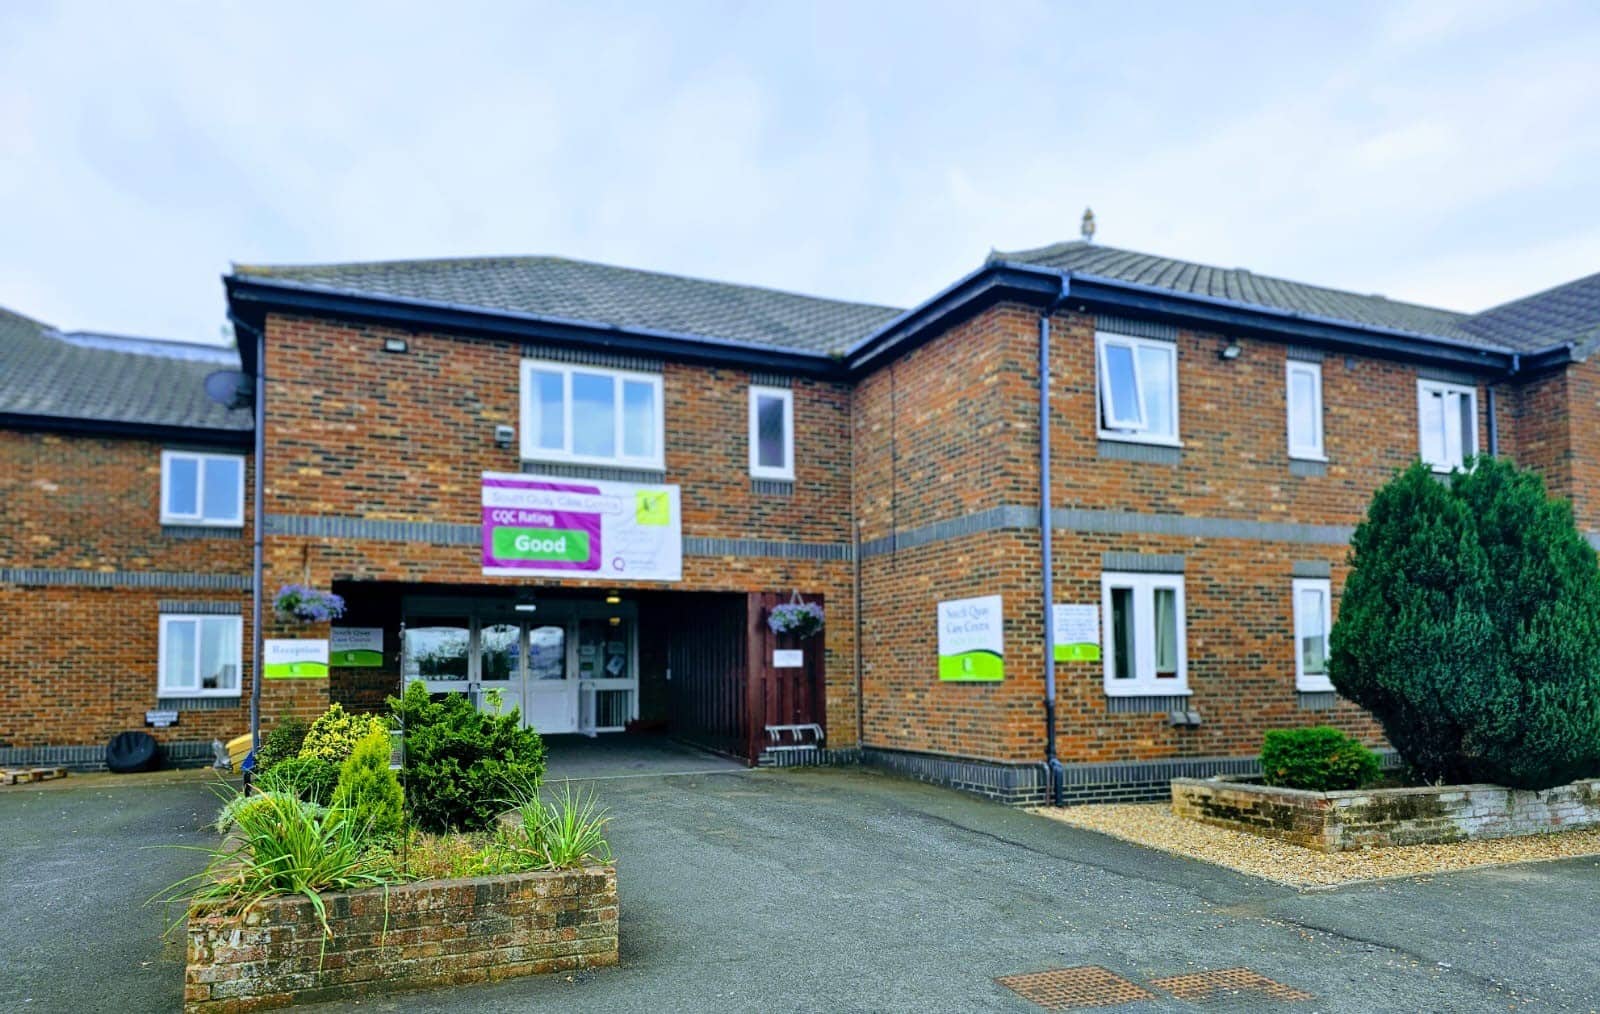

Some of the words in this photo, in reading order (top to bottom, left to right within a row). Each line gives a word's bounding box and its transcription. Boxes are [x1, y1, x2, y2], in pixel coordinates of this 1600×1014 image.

[492, 510, 517, 525] CQC
[519, 511, 555, 527] Rating
[514, 535, 566, 553] Good
[271, 645, 321, 656] Reception
